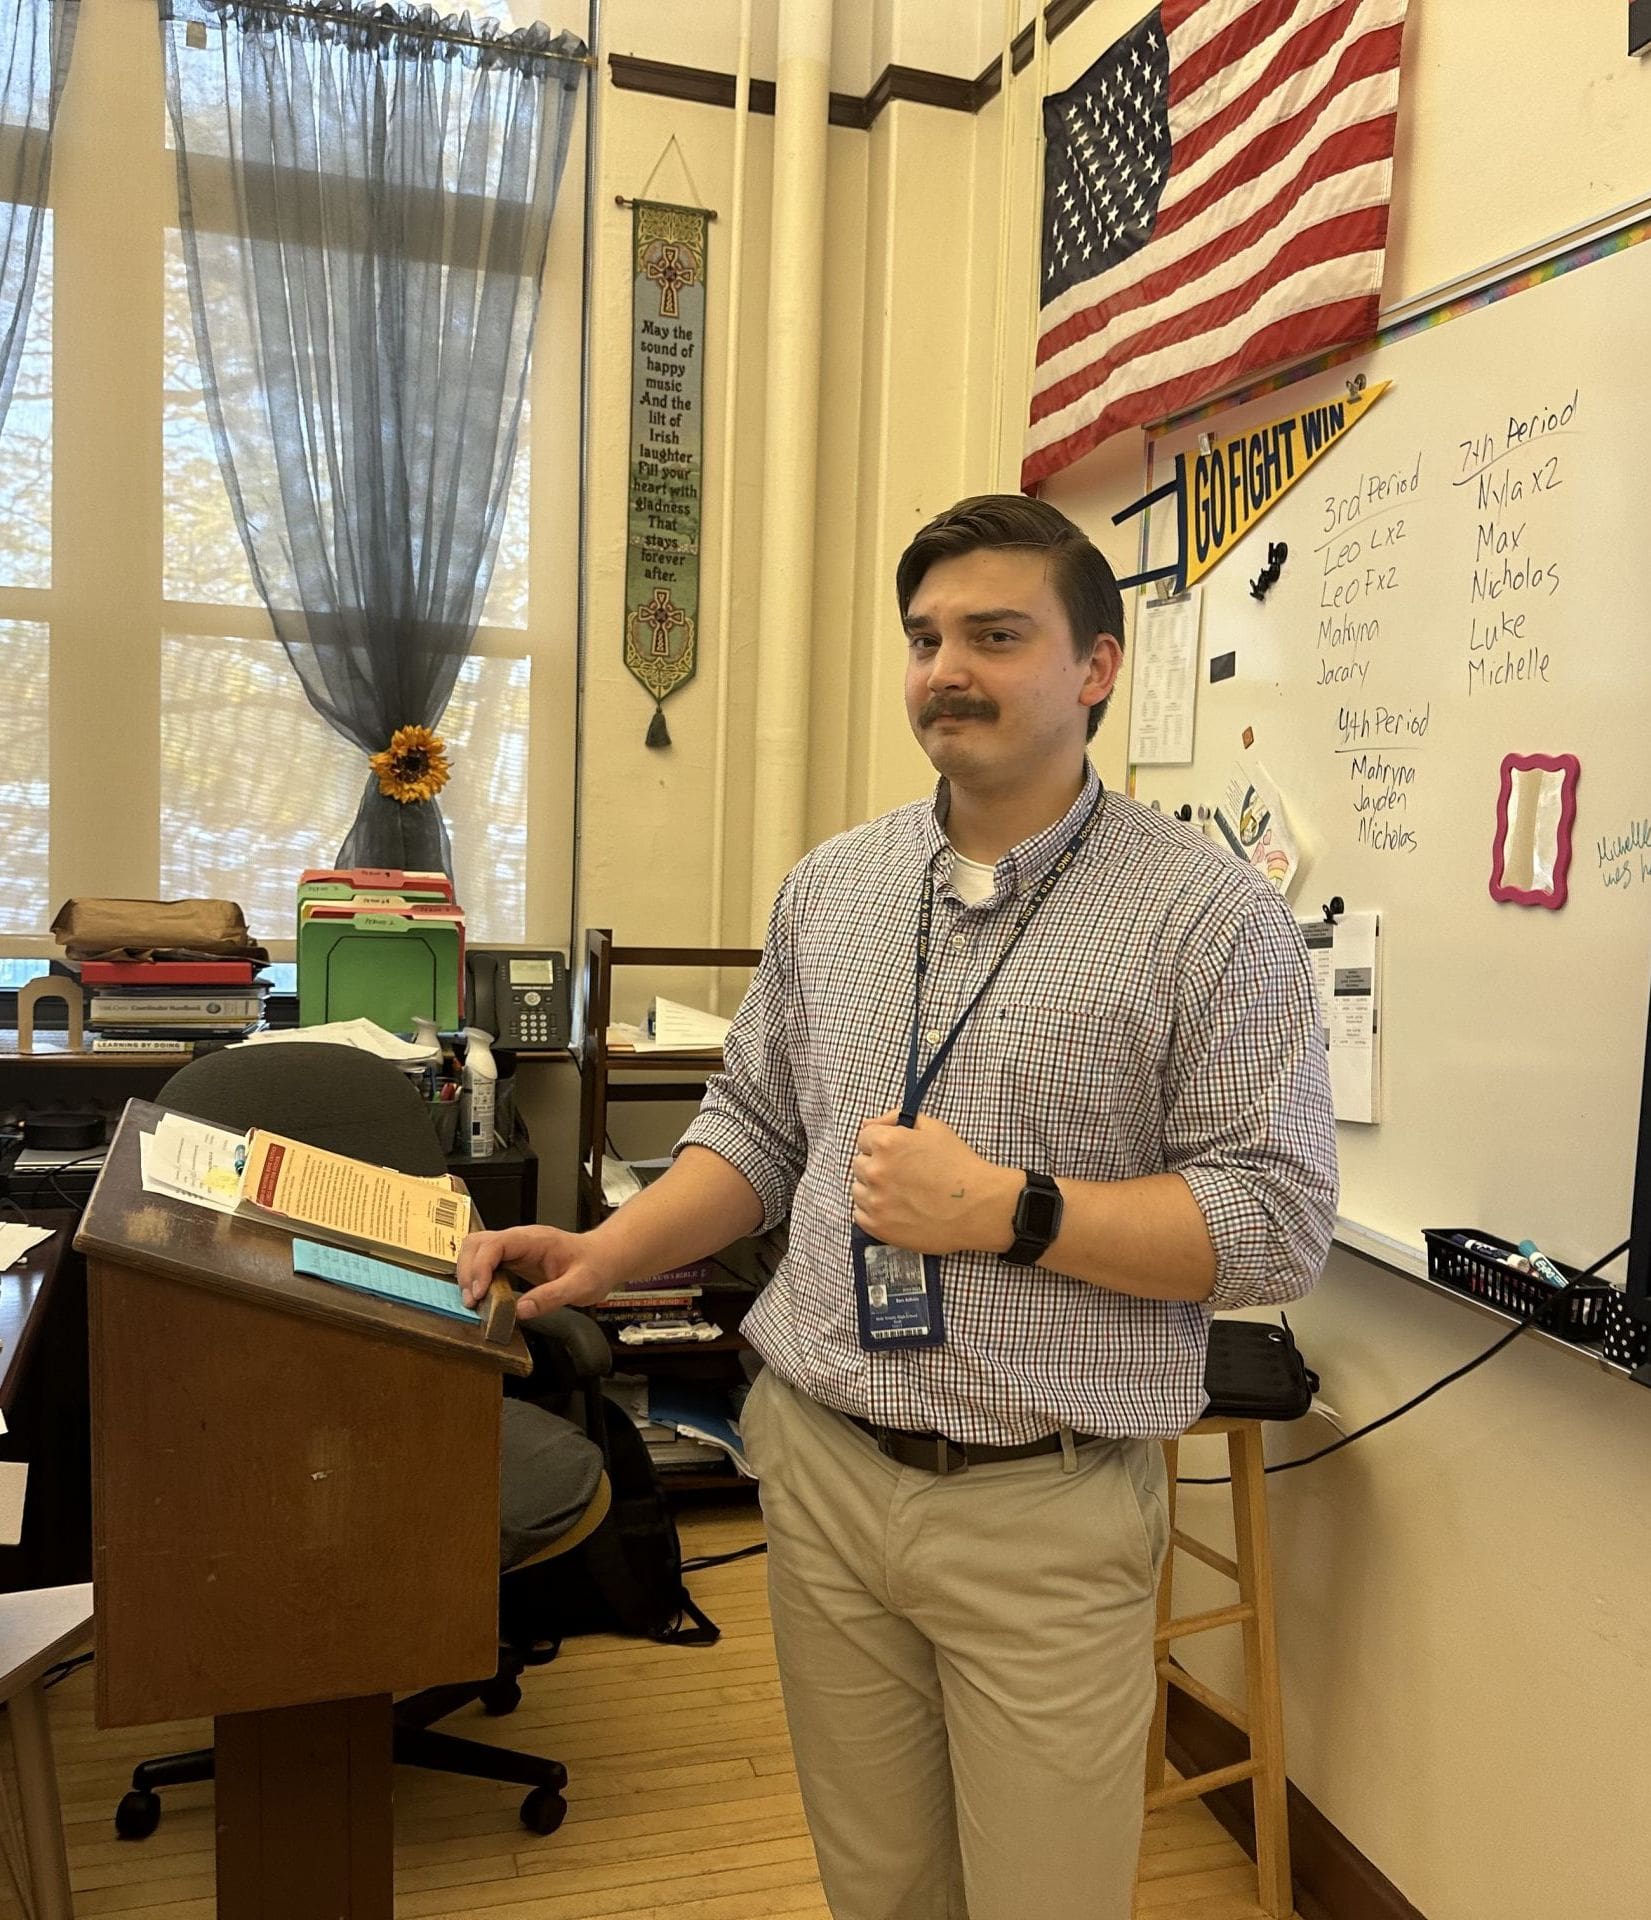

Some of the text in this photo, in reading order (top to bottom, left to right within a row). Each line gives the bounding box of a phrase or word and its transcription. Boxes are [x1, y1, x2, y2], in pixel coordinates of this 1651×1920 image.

[641, 320, 693, 341] May the
[640, 341, 695, 358] sound of
[646, 356, 685, 378] happy
[645, 378, 682, 393] music
[639, 391, 692, 411] And the
[648, 410, 683, 428] lilt of
[649, 428, 680, 445] Irish
[1459, 388, 1579, 473] 7th Period
[639, 443, 693, 464] laughter
[638, 461, 691, 481] Fill your
[632, 477, 698, 499] heart with
[1195, 402, 1345, 564] GO FIGHT WIN
[1323, 451, 1421, 533] 3rd Period
[634, 495, 691, 516] gladness
[1478, 468, 1523, 521] Nyla
[647, 513, 678, 531] That
[644, 533, 679, 550] stays
[1475, 521, 1527, 563] Max
[640, 548, 687, 566] forever
[1323, 540, 1361, 576] Leo
[644, 566, 678, 582] after.
[1470, 556, 1560, 604] Nicholas
[1320, 578, 1360, 608] Leo
[1470, 611, 1526, 651] Luke
[1468, 646, 1550, 697] Michelle
[1338, 701, 1431, 744] 4th Period
[1353, 784, 1408, 817] Jayden
[1358, 816, 1418, 853] Nicholas
[1040, 851, 1074, 894] SINCE 1910
[920, 912, 930, 931] 1910
[1020, 904, 1037, 926] HOLY
[919, 935, 928, 958] SINCE
[97, 1041, 181, 1050] LEARNING BY DOING
